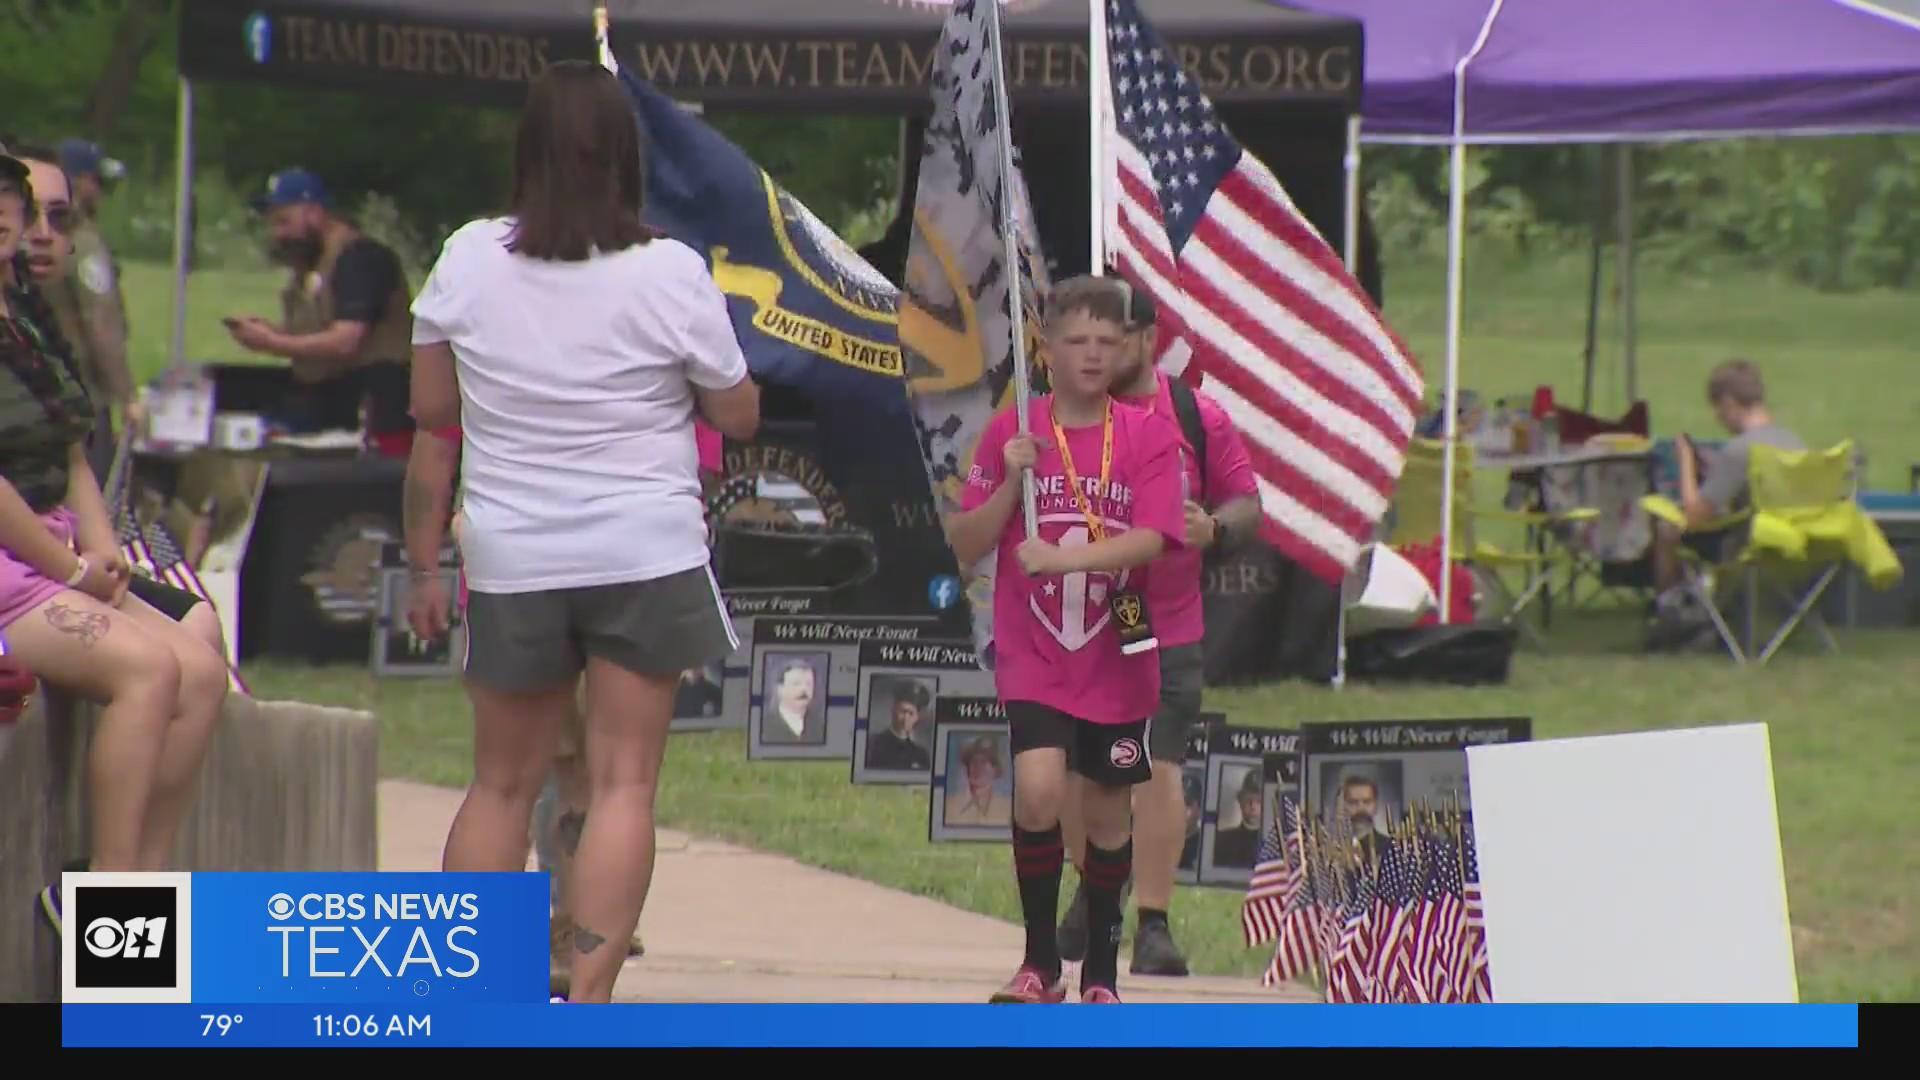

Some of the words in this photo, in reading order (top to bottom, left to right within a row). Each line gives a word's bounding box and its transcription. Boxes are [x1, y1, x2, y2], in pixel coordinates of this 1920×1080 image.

[282, 16, 369, 66] TEAM
[377, 24, 550, 82] DEFENDERS
[763, 309, 834, 350] UNITED
[841, 337, 900, 371] STATES
[725, 446, 857, 530] DEFENDER
[1034, 475, 1065, 497] NE
[774, 623, 797, 639] We
[799, 622, 834, 639] Will
[832, 623, 873, 641] Never
[875, 625, 919, 641] Forget
[880, 646, 904, 661] We
[907, 645, 941, 662] Will
[940, 648, 978, 664] Neve
[958, 702, 982, 718] We
[1231, 732, 1258, 750] We
[1261, 735, 1299, 753] Will
[1330, 727, 1359, 745] We
[1361, 726, 1402, 745] Will
[1402, 726, 1454, 745] Never
